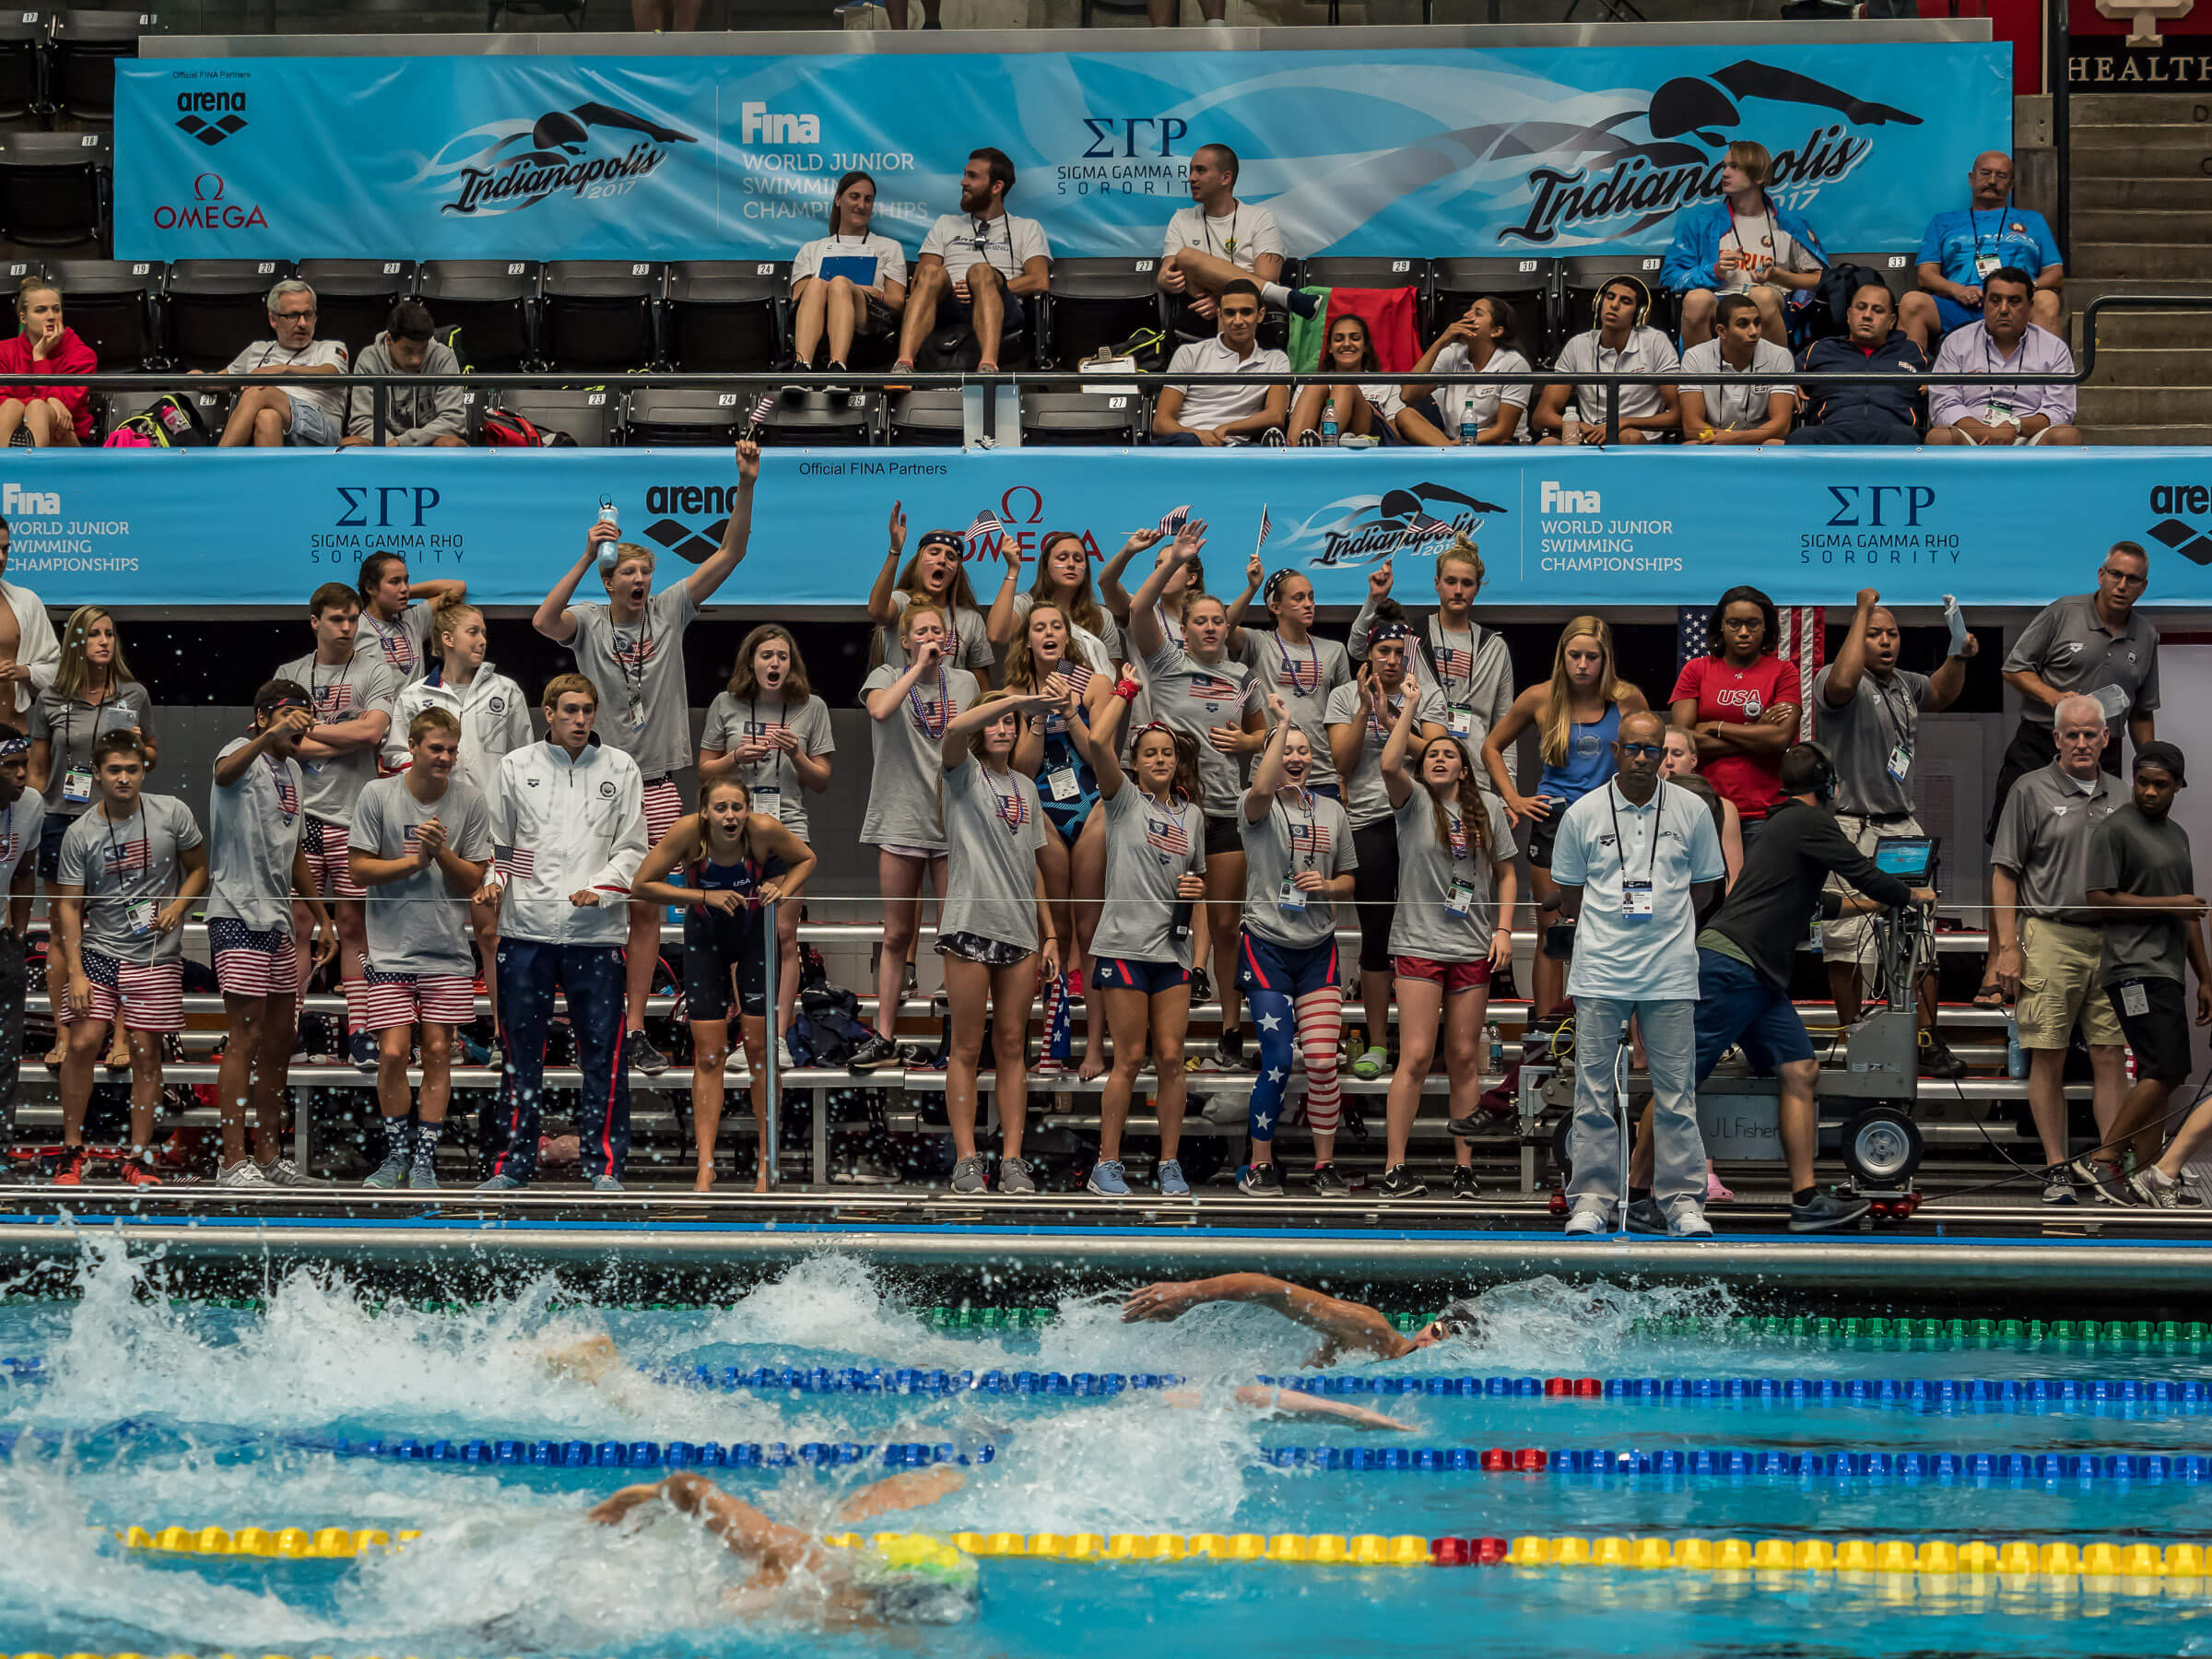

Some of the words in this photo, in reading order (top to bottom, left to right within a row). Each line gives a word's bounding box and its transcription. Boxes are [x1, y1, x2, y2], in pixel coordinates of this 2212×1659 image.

[2068, 55, 2212, 81] HEALTH
[177, 91, 246, 112] arena
[741, 101, 820, 144] Fina
[743, 154, 823, 171] WORLD
[830, 153, 915, 171] JUNIOR
[441, 142, 666, 213] Indianapolis
[1057, 166, 1107, 179] SIGMA
[1112, 165, 1173, 179] GAMMA
[588, 182, 637, 200] 2017
[743, 177, 839, 194] SWIMMI
[1057, 181, 1191, 194] SORORIT
[1498, 124, 1866, 242] Indianaolis
[153, 205, 269, 229] OMEGA
[743, 201, 929, 219] CHAMPIHIPS
[799, 463, 846, 476] Official
[851, 463, 885, 476] FINA
[888, 463, 947, 476] Partners
[3, 483, 61, 514] Fina
[1540, 481, 1601, 513] Fina
[2150, 485, 2212, 514] are
[8, 522, 63, 535] WORLD
[66, 522, 130, 535] JUNIOR
[1541, 521, 1604, 535] WORLD
[1607, 521, 1673, 535] JUNIOR
[311, 535, 360, 547] SIGMA
[365, 535, 426, 547] GAMMA
[430, 535, 464, 547] RHO
[1541, 538, 1634, 553] SWIMMING
[1800, 535, 1853, 547] SIGMA
[1857, 535, 1920, 547] GAMMA
[1924, 534, 1959, 547] RHO
[311, 550, 465, 563] SORRITY
[1422, 542, 1455, 557] 201
[1800, 550, 1960, 564] SORORITY
[6, 558, 139, 571] CHAMPIONSHIPS
[1541, 557, 1683, 571] CHAMPIONSHIPS
[1716, 689, 1762, 707] USA
[733, 877, 751, 888] USA
